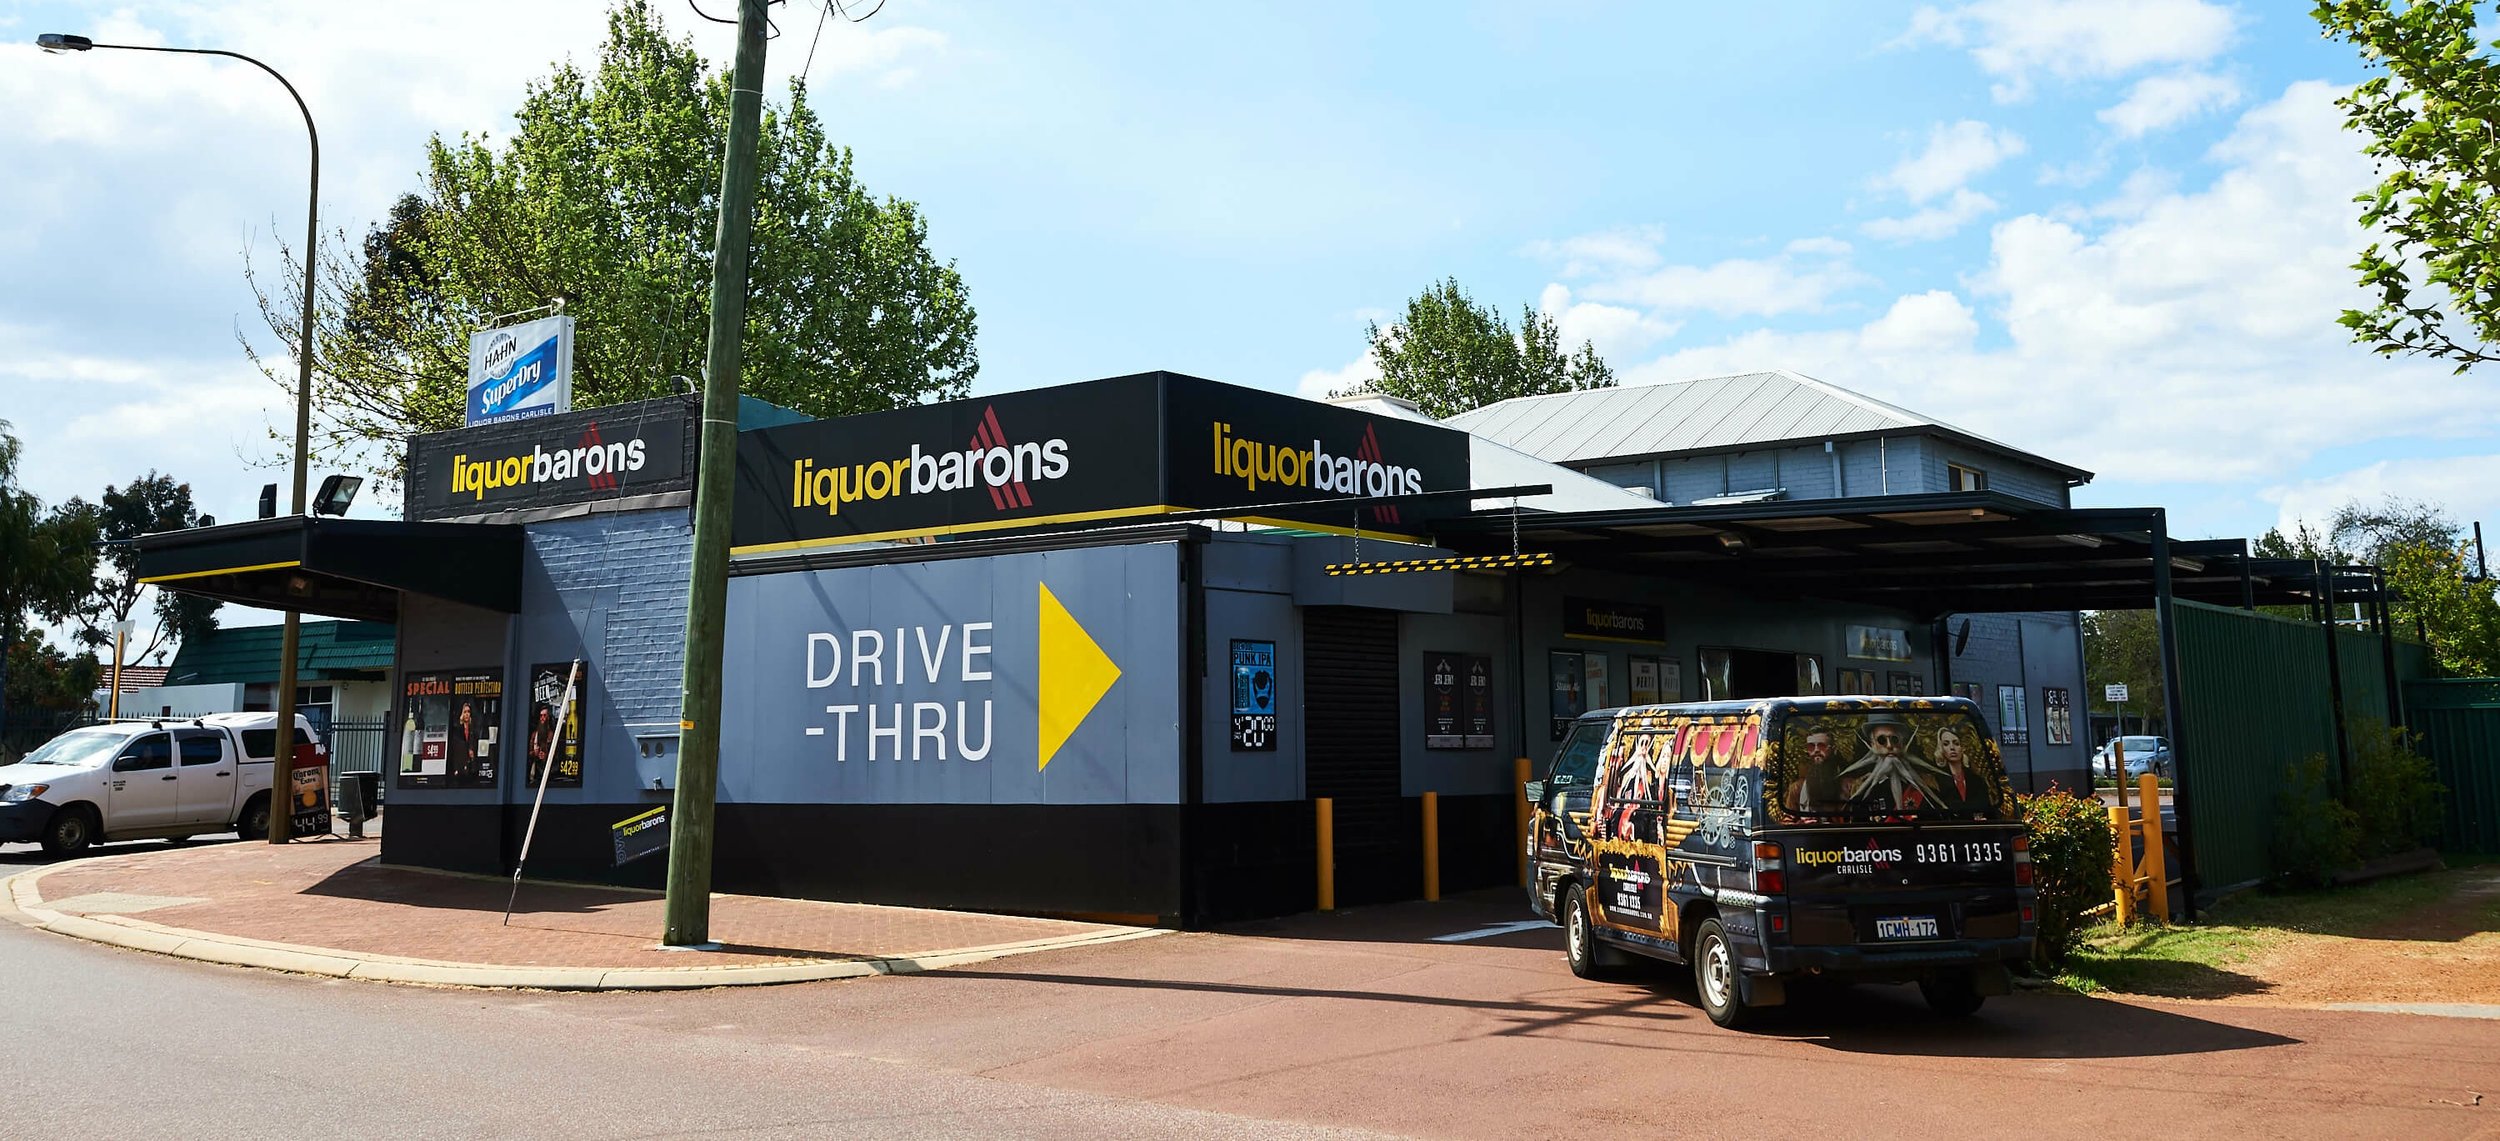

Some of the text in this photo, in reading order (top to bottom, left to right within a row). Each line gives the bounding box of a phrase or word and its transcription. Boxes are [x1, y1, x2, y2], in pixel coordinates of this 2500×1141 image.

[484, 336, 517, 371] HAHN
[481, 359, 541, 414] SuperDry
[468, 407, 553, 428] LIQUOR BARONS CARLISLE
[452, 438, 645, 500] liquorbarons
[1213, 421, 1422, 498] liquorbarons
[793, 438, 1069, 516] liquorbarons
[1586, 608, 1644, 632] liquorbarons
[807, 622, 993, 688] DRIVE
[1233, 653, 1272, 666] PUNK IPA
[407, 681, 450, 696] SPECIAL
[805, 700, 992, 762] -THRU
[623, 815, 665, 836] liquorbarons
[1795, 847, 1902, 867] liquorbarons
[1916, 842, 2003, 863] 9361 1335
[1837, 863, 1873, 874] CARLISLE
[1617, 892, 1629, 907] 9361
